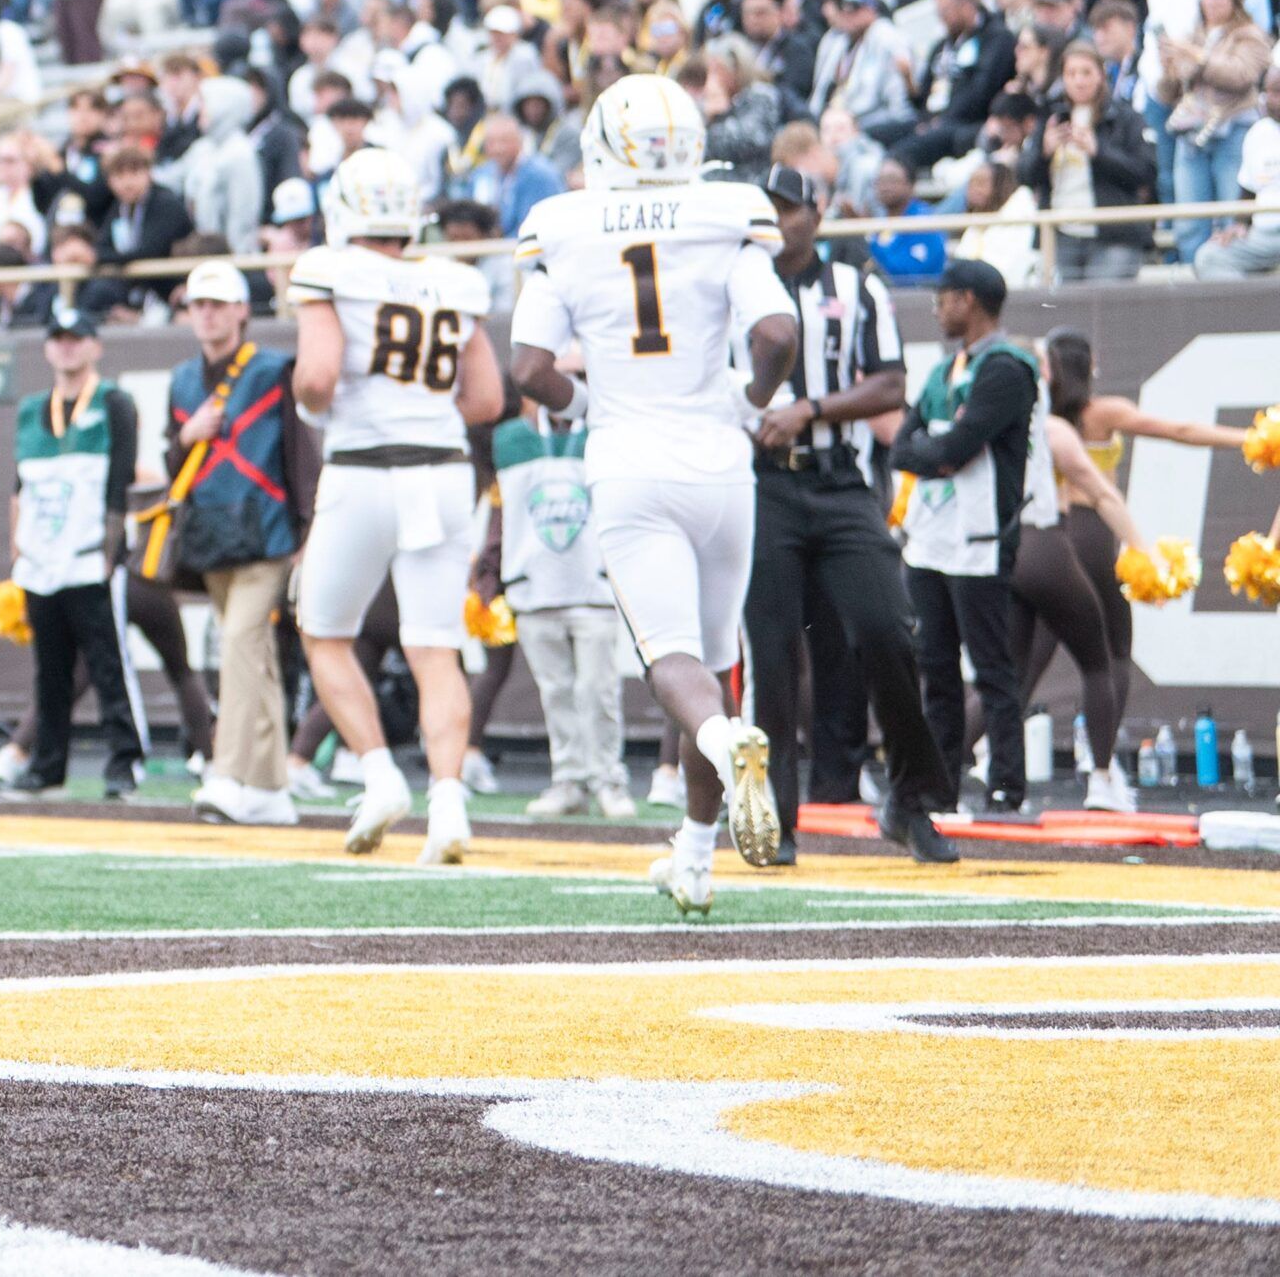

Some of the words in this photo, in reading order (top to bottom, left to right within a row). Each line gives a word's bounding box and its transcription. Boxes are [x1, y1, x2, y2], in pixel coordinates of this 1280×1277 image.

[602, 201, 680, 233] LEARY
[620, 242, 672, 357] 1
[369, 301, 461, 395] 86
